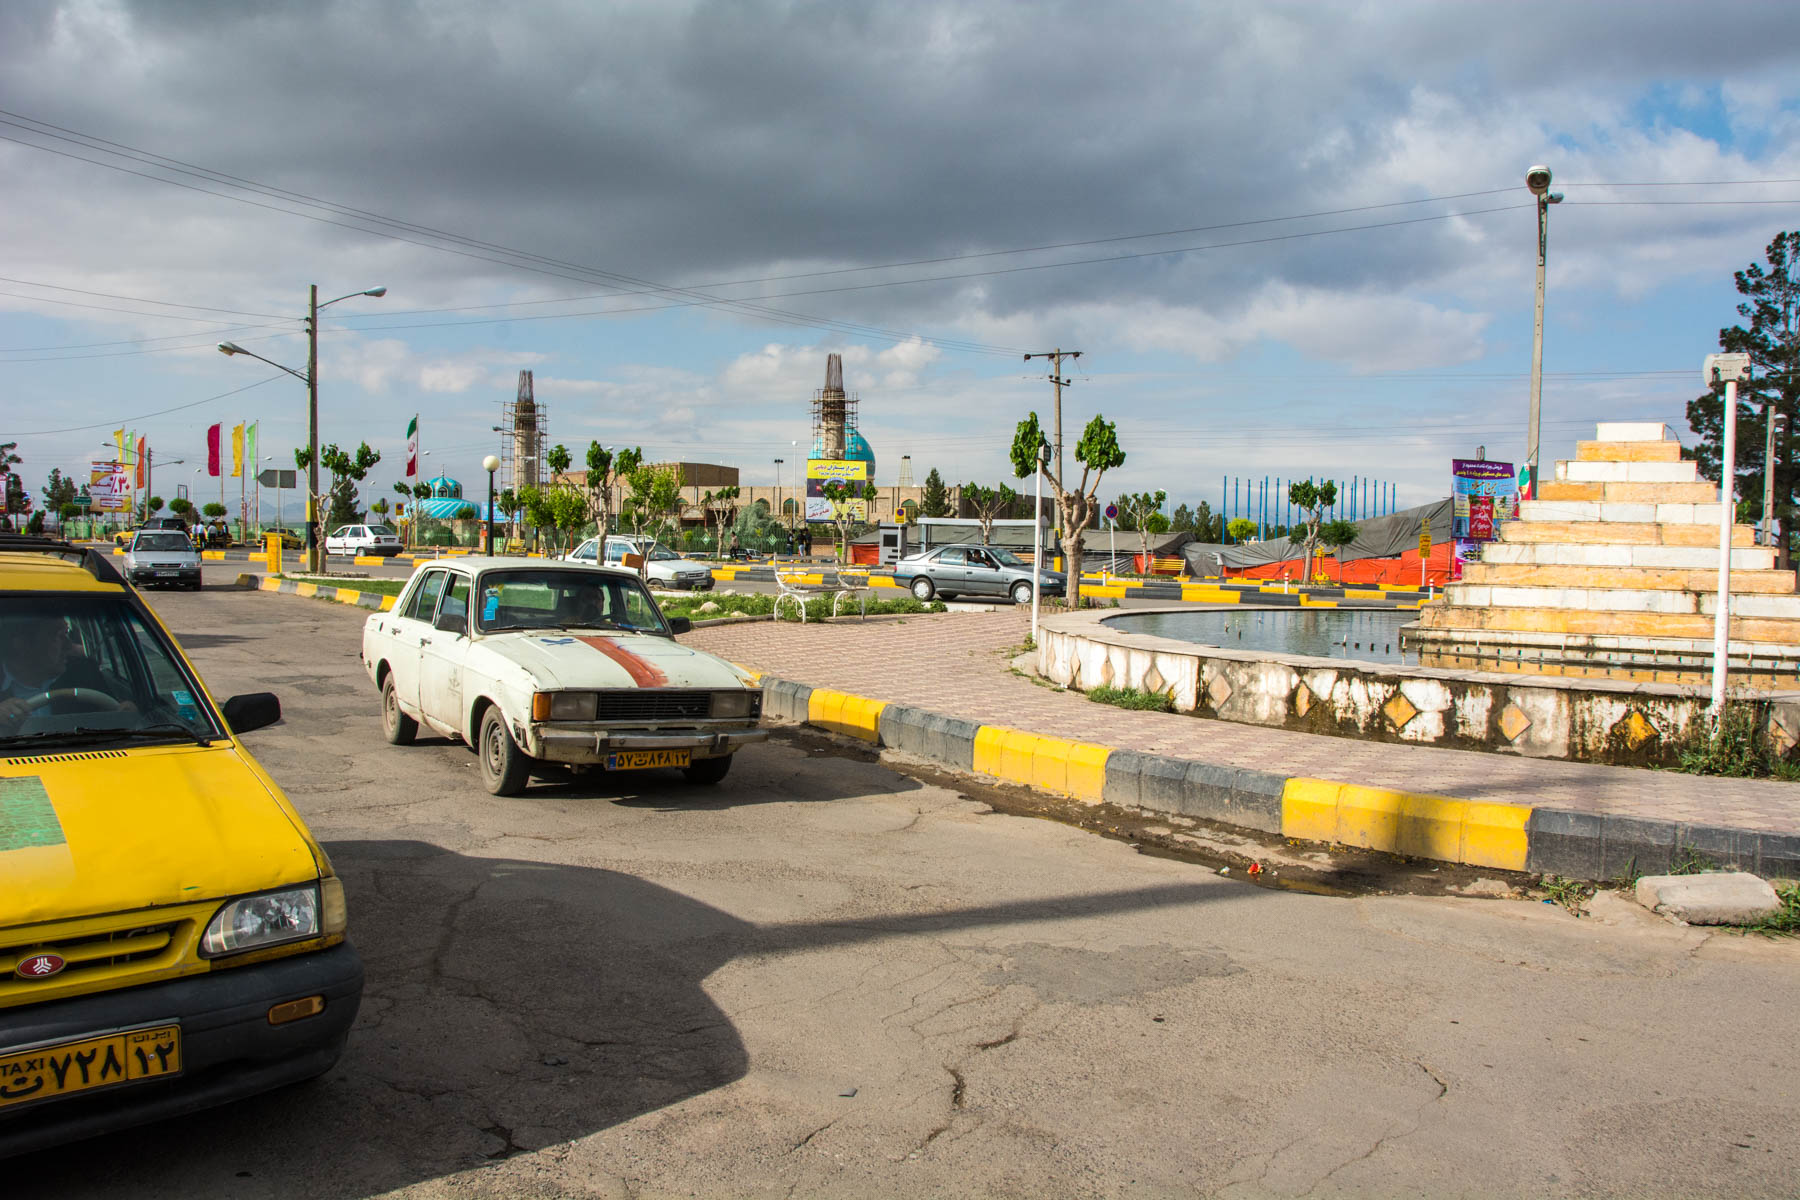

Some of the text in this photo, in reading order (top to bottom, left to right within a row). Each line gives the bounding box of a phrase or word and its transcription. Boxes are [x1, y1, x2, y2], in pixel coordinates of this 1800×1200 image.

[133, 1030, 172, 1043] ایران
[0, 1057, 45, 1077] TAXI
[49, 1044, 122, 1090] ۷۲۸
[135, 1040, 175, 1075] ۱۲
